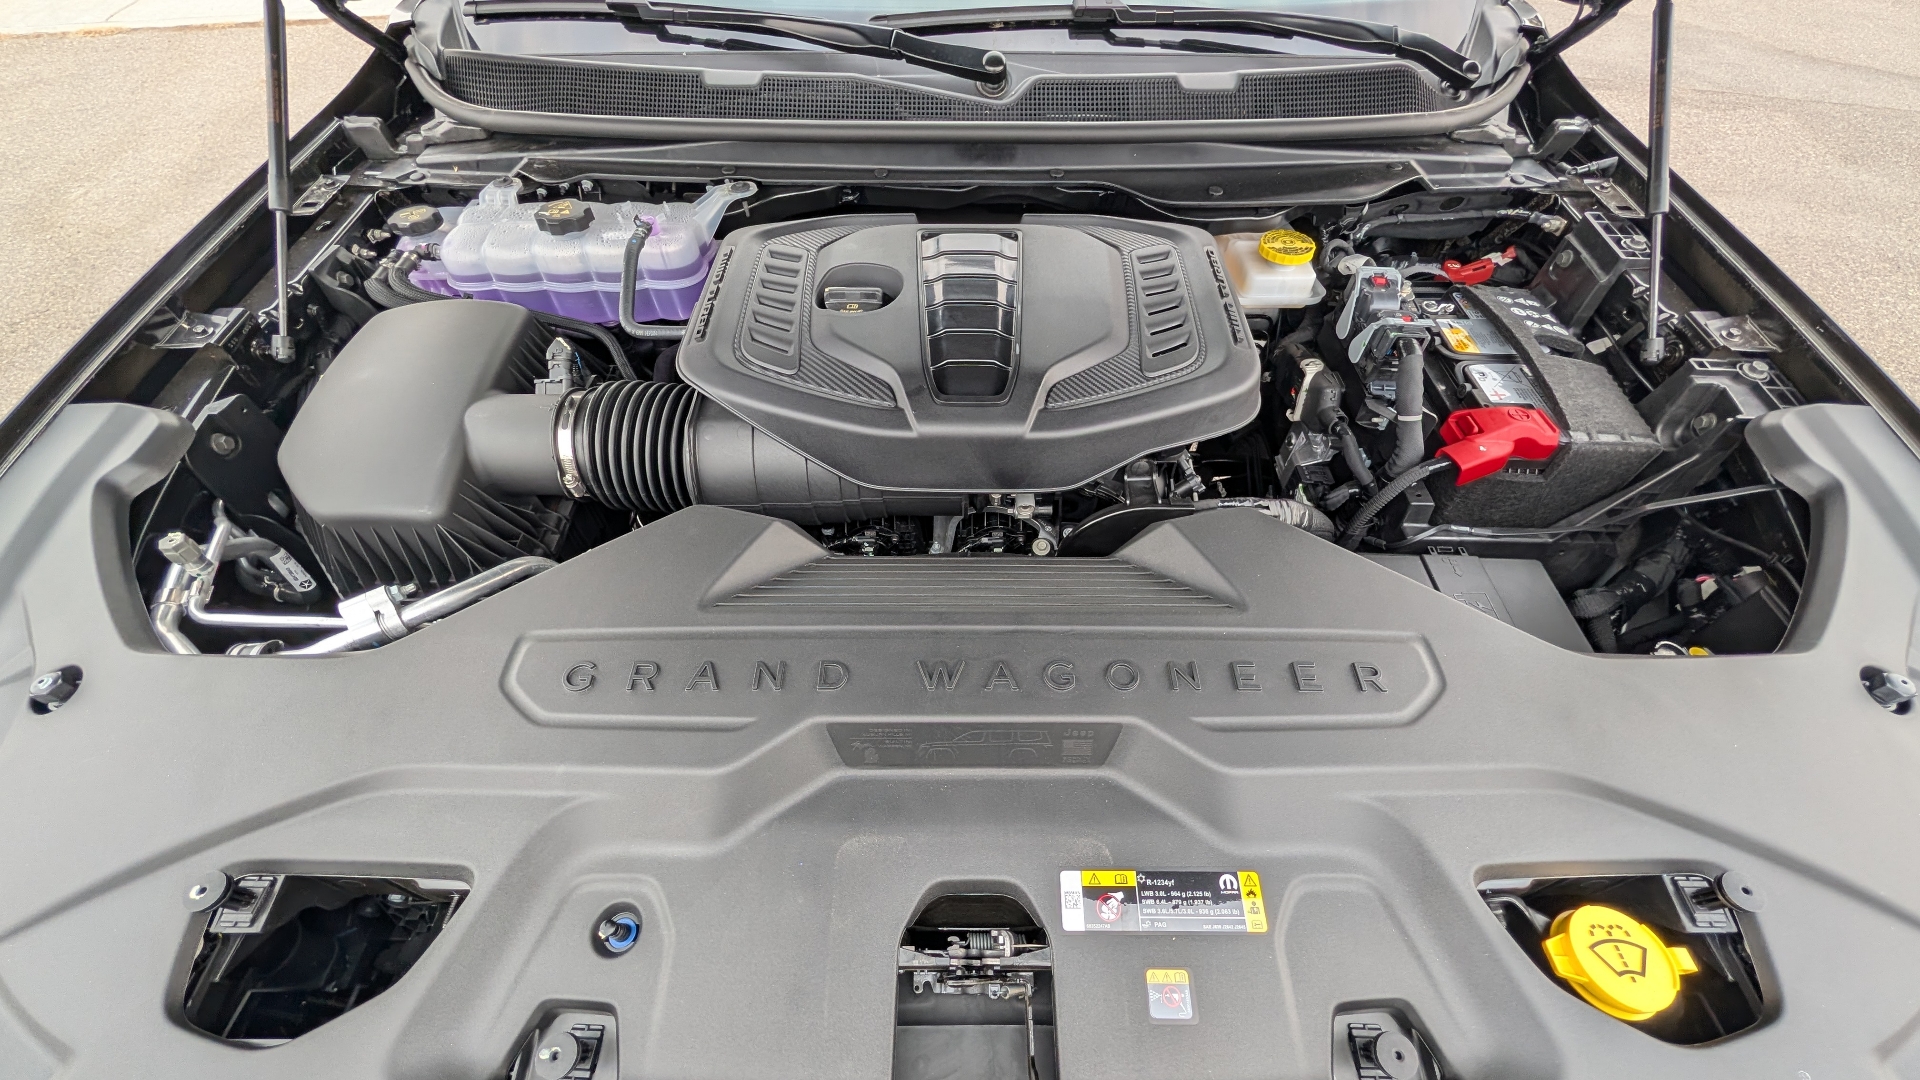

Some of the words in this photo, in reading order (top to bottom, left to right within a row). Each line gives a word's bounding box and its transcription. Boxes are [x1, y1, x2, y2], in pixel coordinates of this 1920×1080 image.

[561, 660, 850, 692] GRAND
[915, 660, 1388, 692] WAGONEER
[1062, 728, 1094, 737] Jeep
[1146, 879, 1174, 887] R-1234yf
